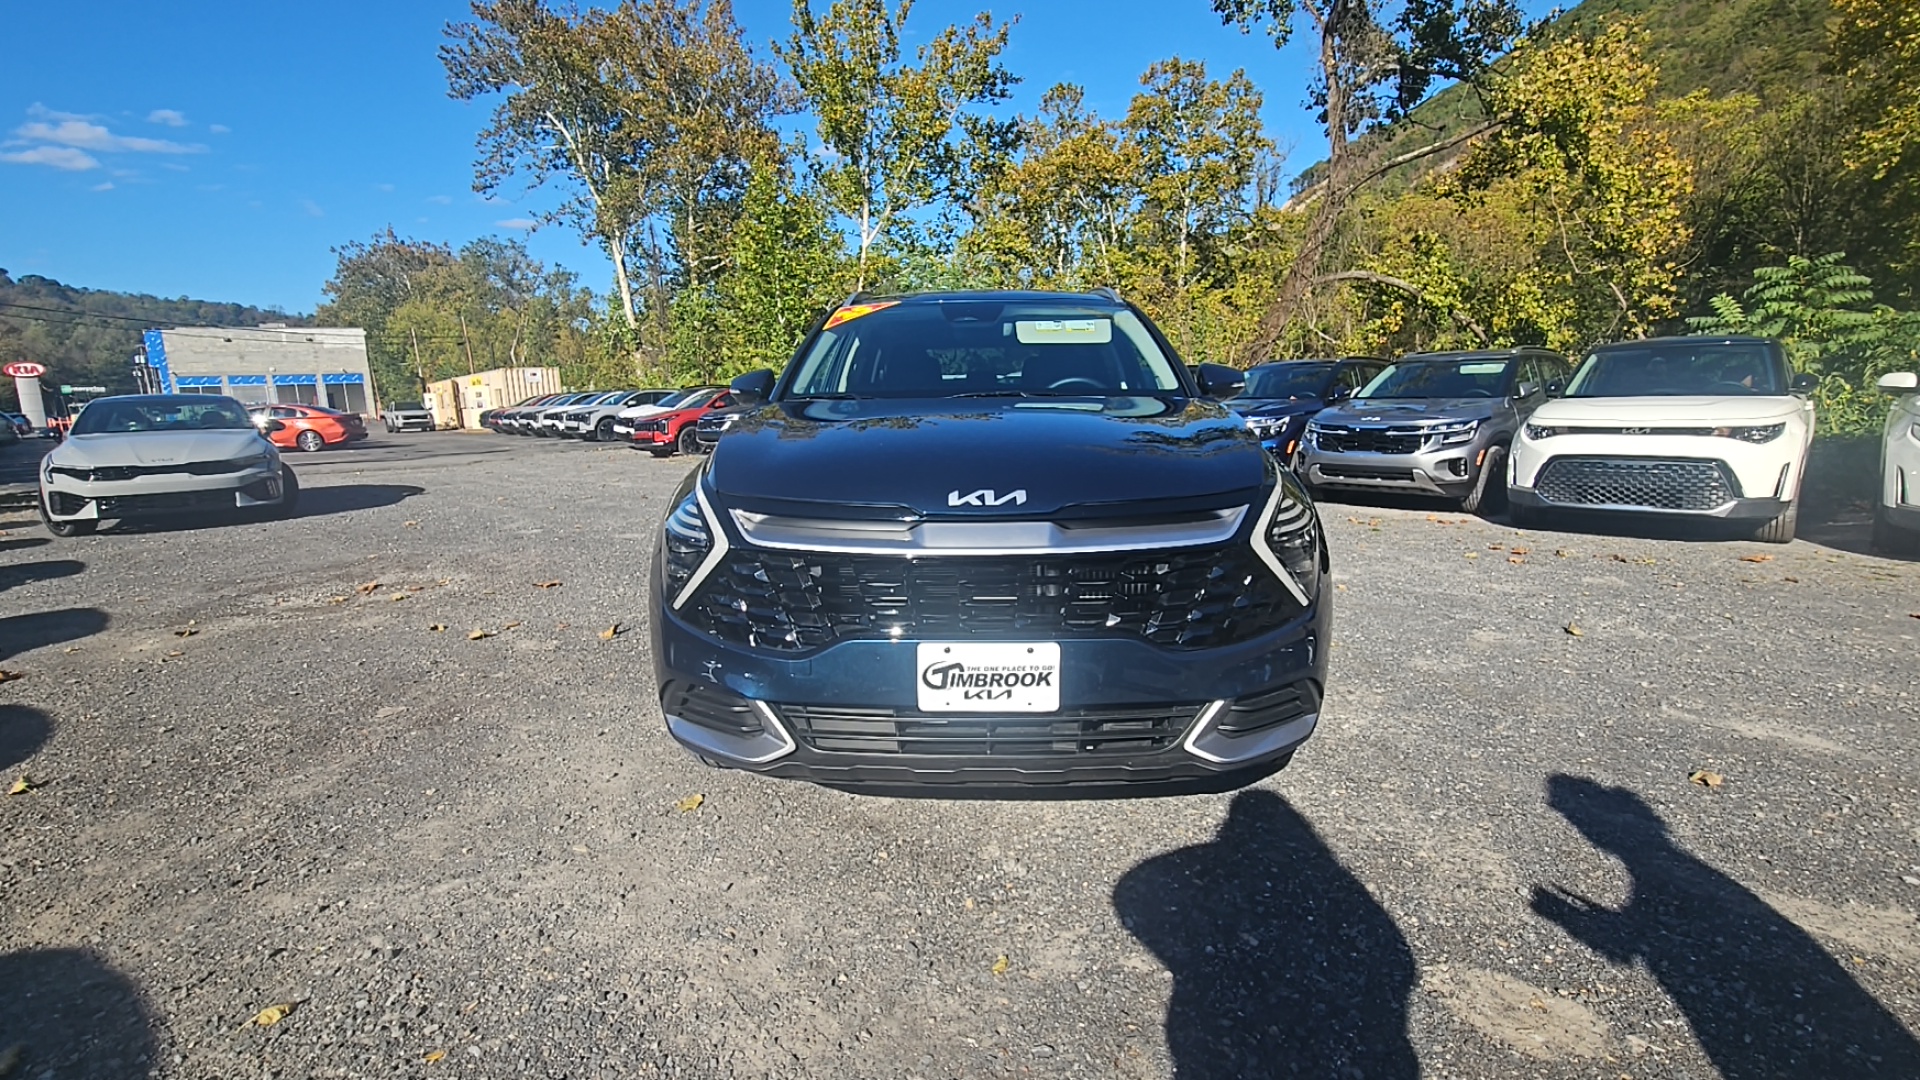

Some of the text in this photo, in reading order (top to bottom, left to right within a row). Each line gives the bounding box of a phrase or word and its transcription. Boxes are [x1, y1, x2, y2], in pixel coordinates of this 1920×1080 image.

[12, 366, 41, 375] KIA
[947, 489, 1027, 507] KIA
[923, 661, 1053, 689] TIMBROOK
[963, 688, 1012, 700] KIA
